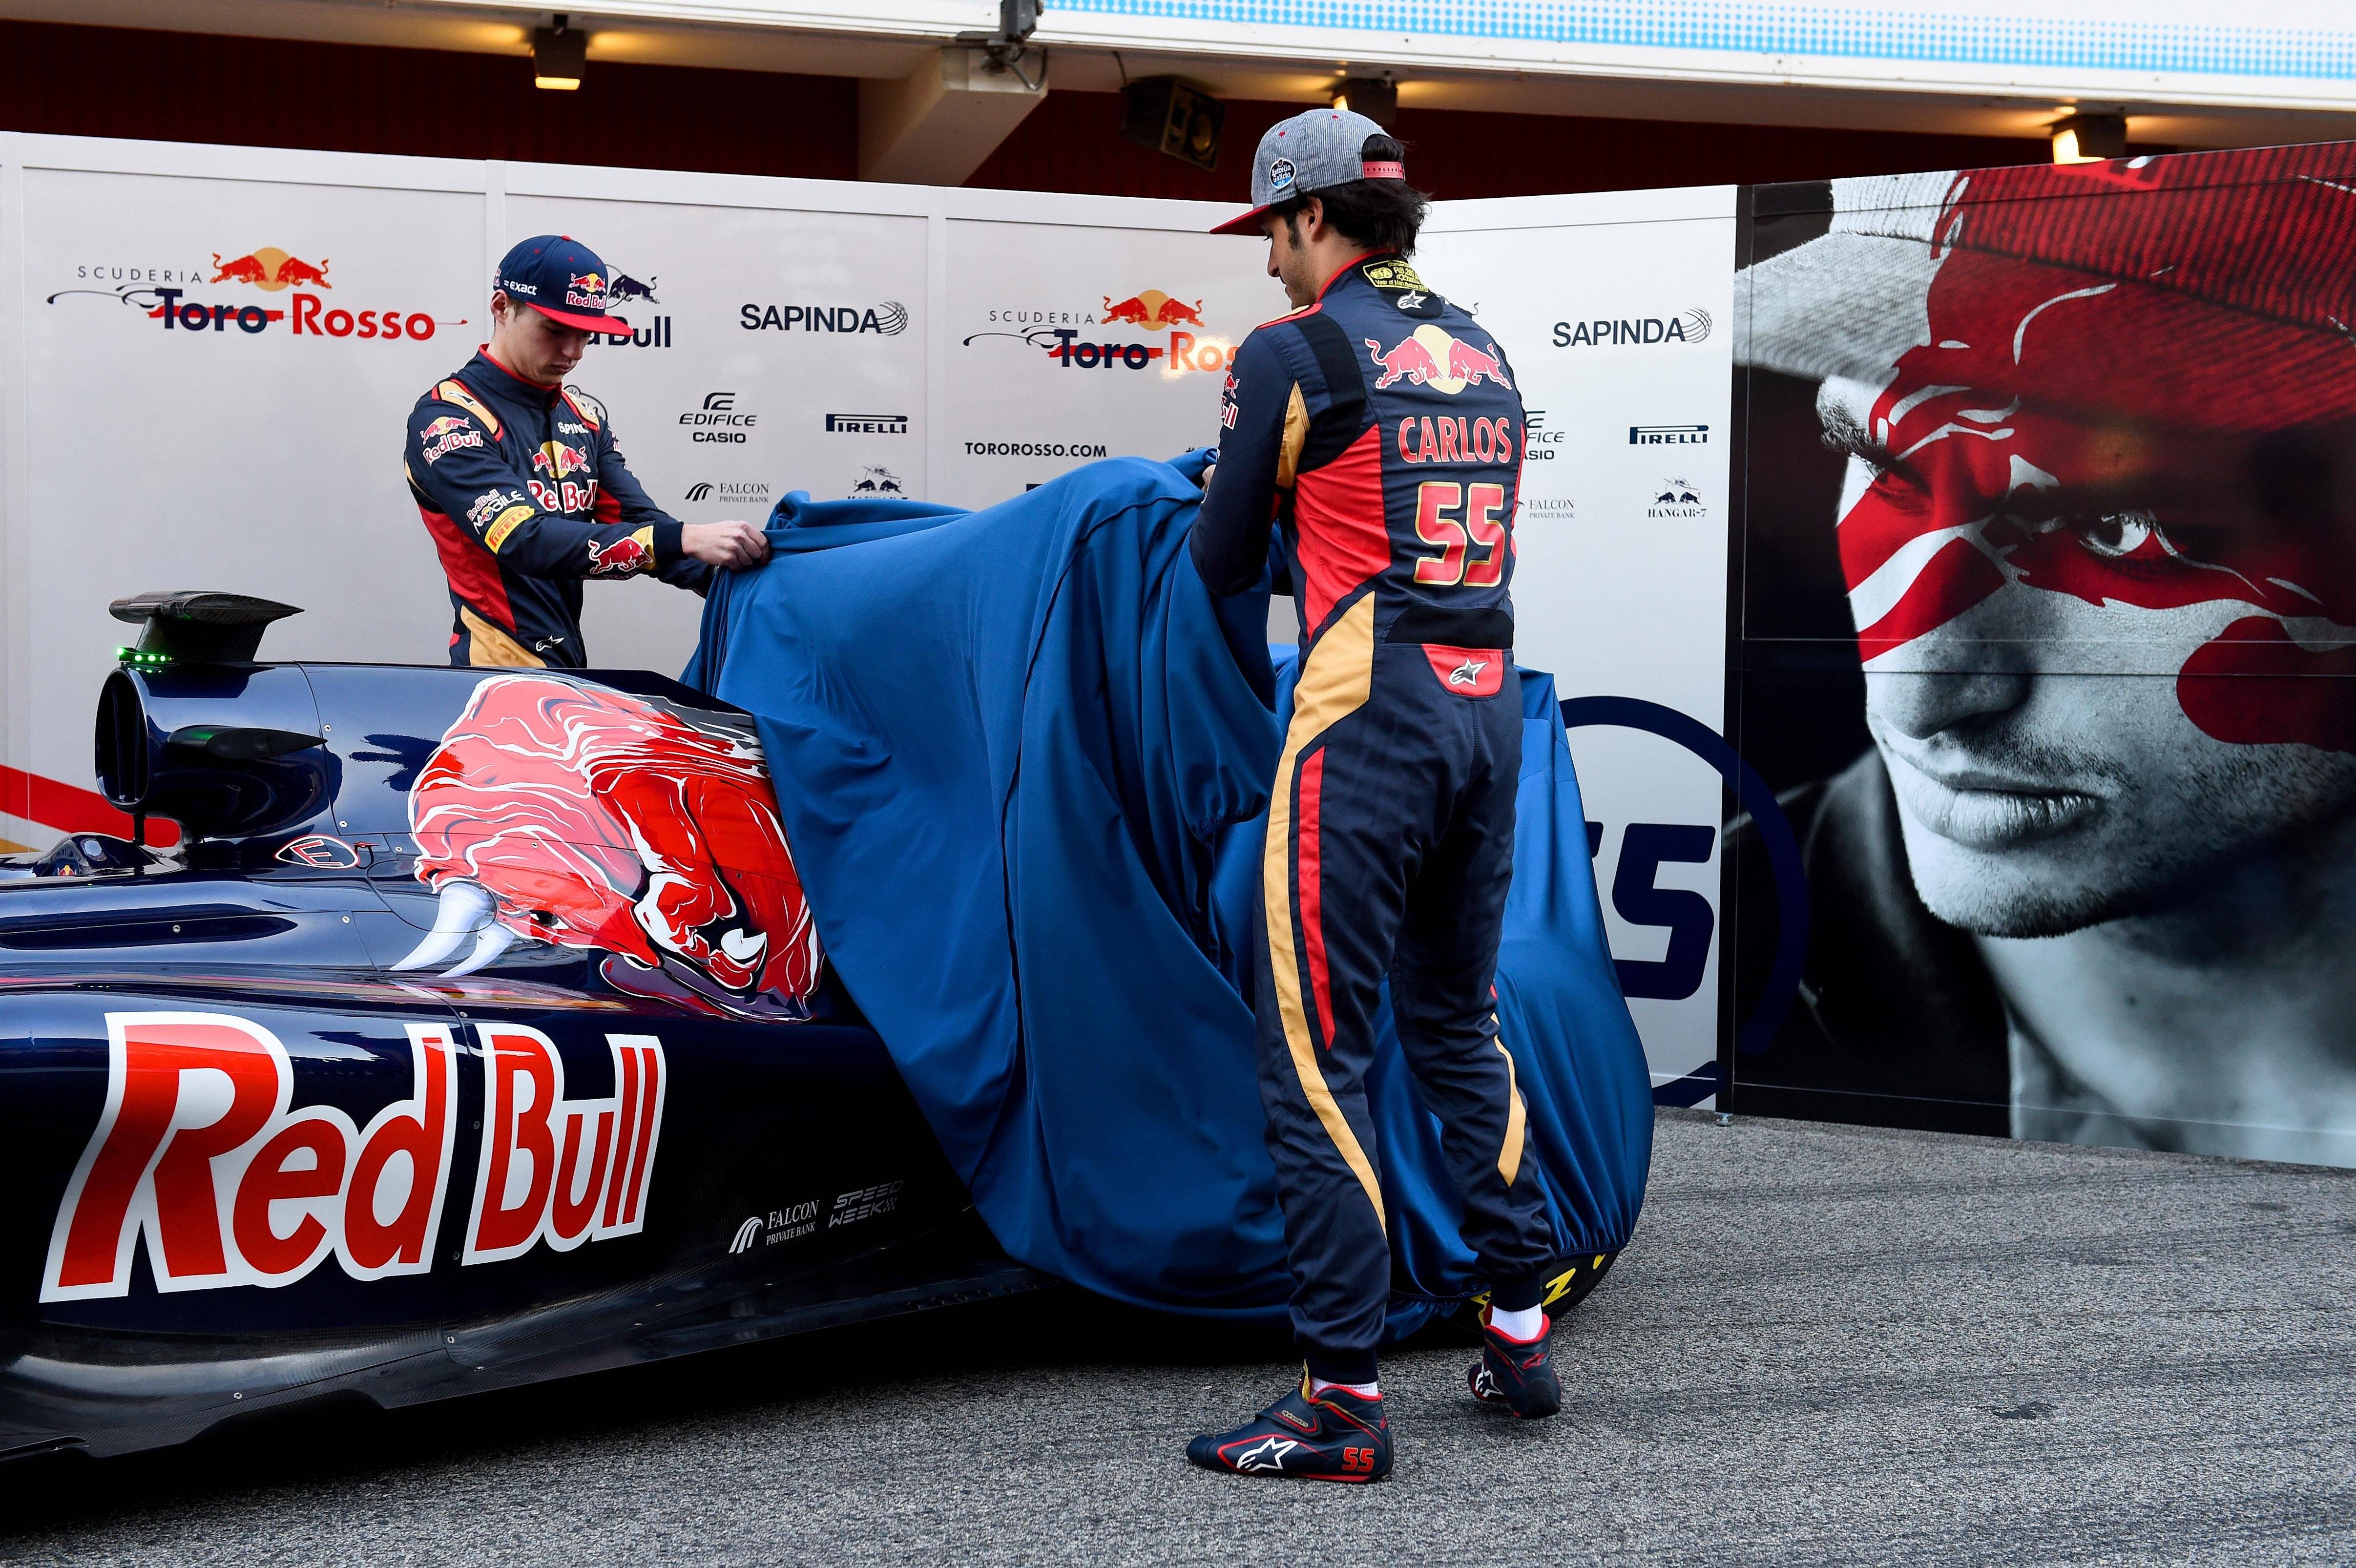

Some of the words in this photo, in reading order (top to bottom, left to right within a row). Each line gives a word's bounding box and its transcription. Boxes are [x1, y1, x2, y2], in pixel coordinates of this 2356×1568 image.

[1272, 165, 1291, 176] Estrella
[78, 265, 202, 284] SCUDERIA
[510, 281, 537, 295] exact
[566, 291, 590, 307] Red
[590, 294, 607, 309] Bull
[155, 288, 268, 334] Toro
[293, 293, 435, 340] Rosso
[740, 304, 881, 334] SAPINDA
[989, 311, 1095, 325] SCUDERIA
[1553, 317, 1686, 347] SAPINDA
[1054, 329, 1149, 370] Toro
[679, 413, 756, 426] EDIFICE
[826, 414, 908, 434] PIRELLI
[692, 432, 746, 443] CASIO
[1398, 417, 1512, 463] CARLOS
[1527, 432, 1564, 442] FICE
[1629, 425, 1709, 444] PIRELLI
[423, 435, 450, 466] Red
[447, 431, 483, 450] Bull
[965, 442, 1106, 457] TOROROSSO.COM
[1524, 450, 1554, 460] SIO
[527, 480, 562, 512] Re
[719, 483, 769, 494] FALCON
[466, 499, 482, 522] Red
[479, 488, 500, 509] Bull
[473, 490, 525, 535] MOBILE
[1529, 499, 1575, 509] FALCON
[1648, 508, 1707, 518] HANGAR-7
[489, 507, 530, 548] PIRELLI
[1413, 481, 1506, 587] 55
[1585, 821, 1716, 1000] 5
[39, 1011, 458, 1303] Red
[461, 1023, 667, 1266] Bull
[834, 1179, 903, 1209] SPEED
[767, 1199, 820, 1230] FALCON
[766, 1227, 795, 1246] PRIVATE
[796, 1222, 816, 1236] BANK
[1342, 1446, 1375, 1472] 55
